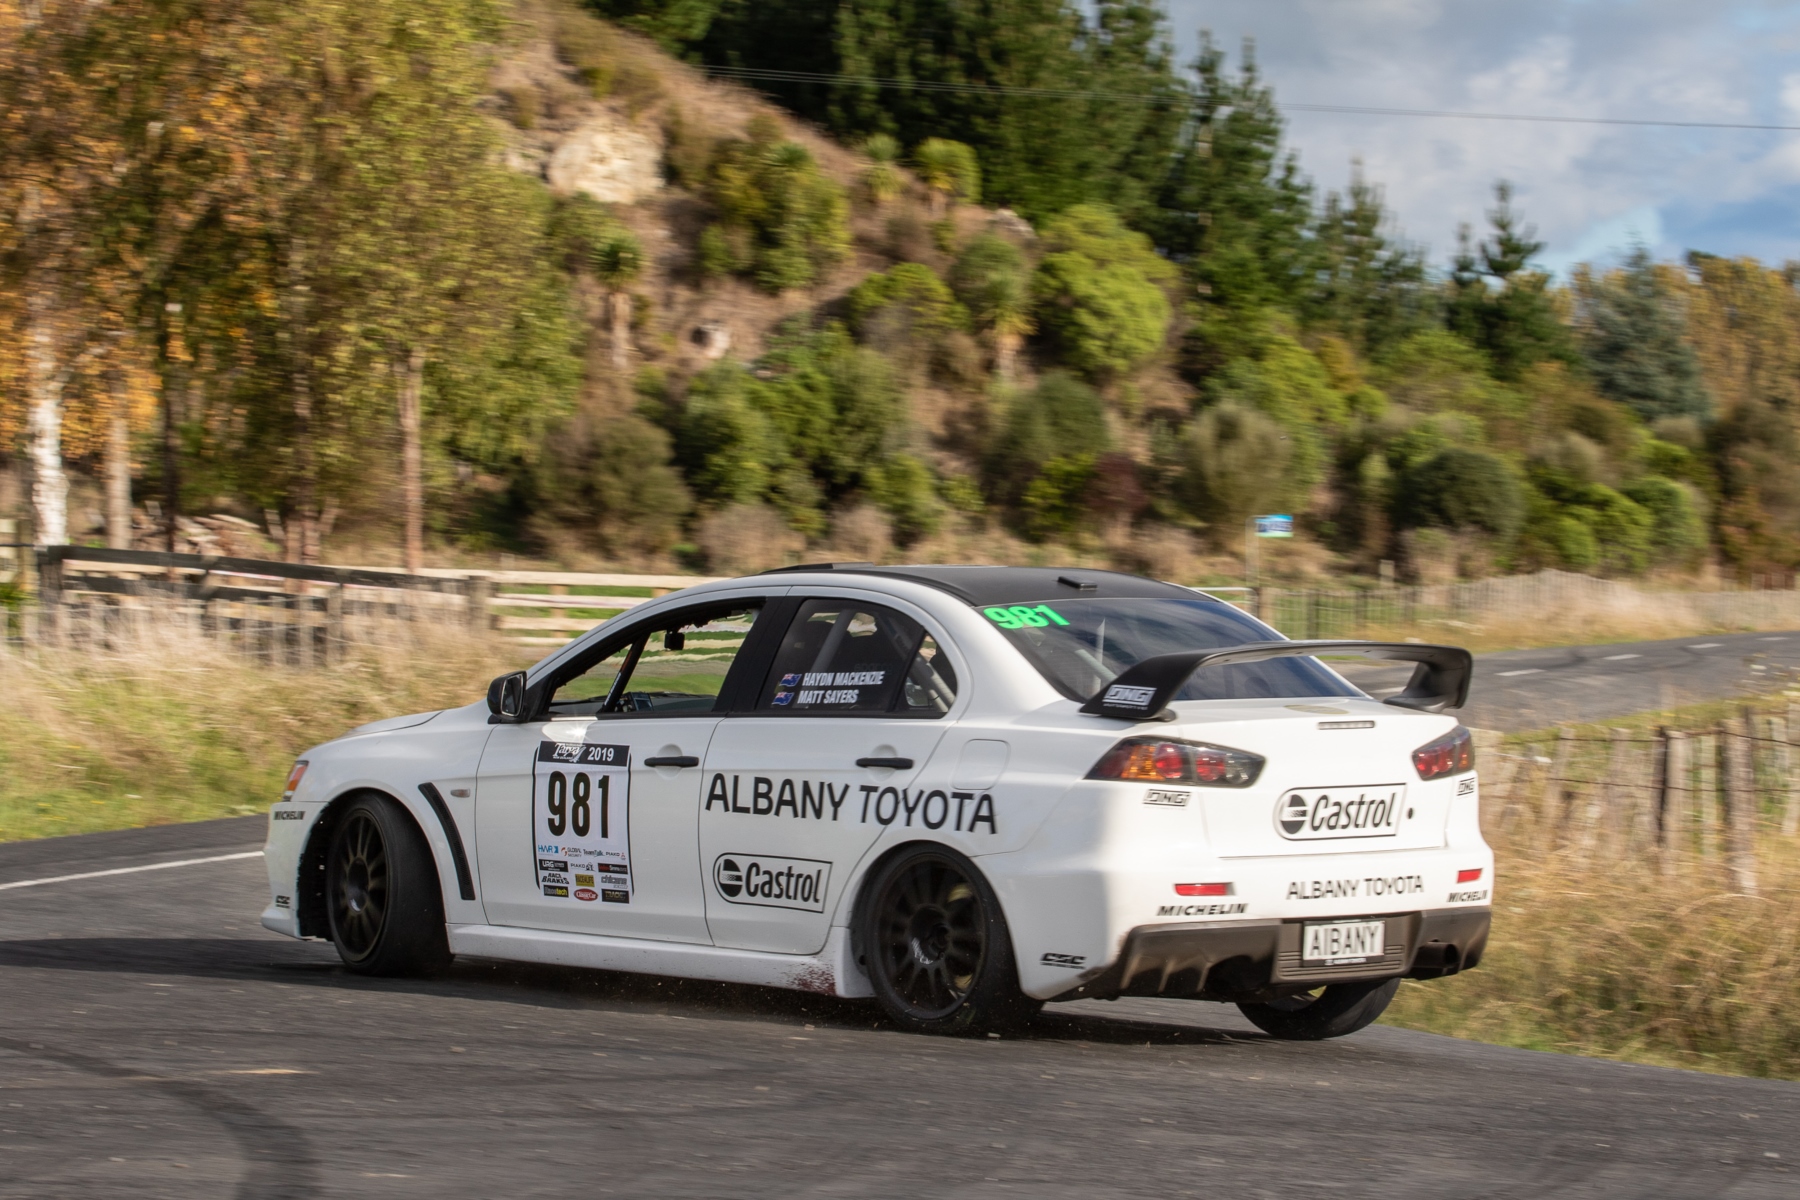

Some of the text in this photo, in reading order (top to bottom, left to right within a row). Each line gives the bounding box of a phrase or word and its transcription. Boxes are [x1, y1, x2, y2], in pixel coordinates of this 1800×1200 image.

[983, 604, 1070, 629] 981
[802, 671, 885, 686] HAYDN MACKENZIE
[797, 689, 859, 704] MATT SAYERS
[587, 747, 615, 762] 2019
[548, 771, 610, 838] 981
[705, 773, 997, 834] ALBANY TOYOTA
[1311, 792, 1396, 831] Castrol
[274, 810, 306, 820] MICHELIN
[745, 862, 822, 903] Castrol
[1286, 875, 1424, 900] ALBANY TOYOTA
[1447, 890, 1487, 902] MICHELIN
[1157, 903, 1248, 917] MICHELIN
